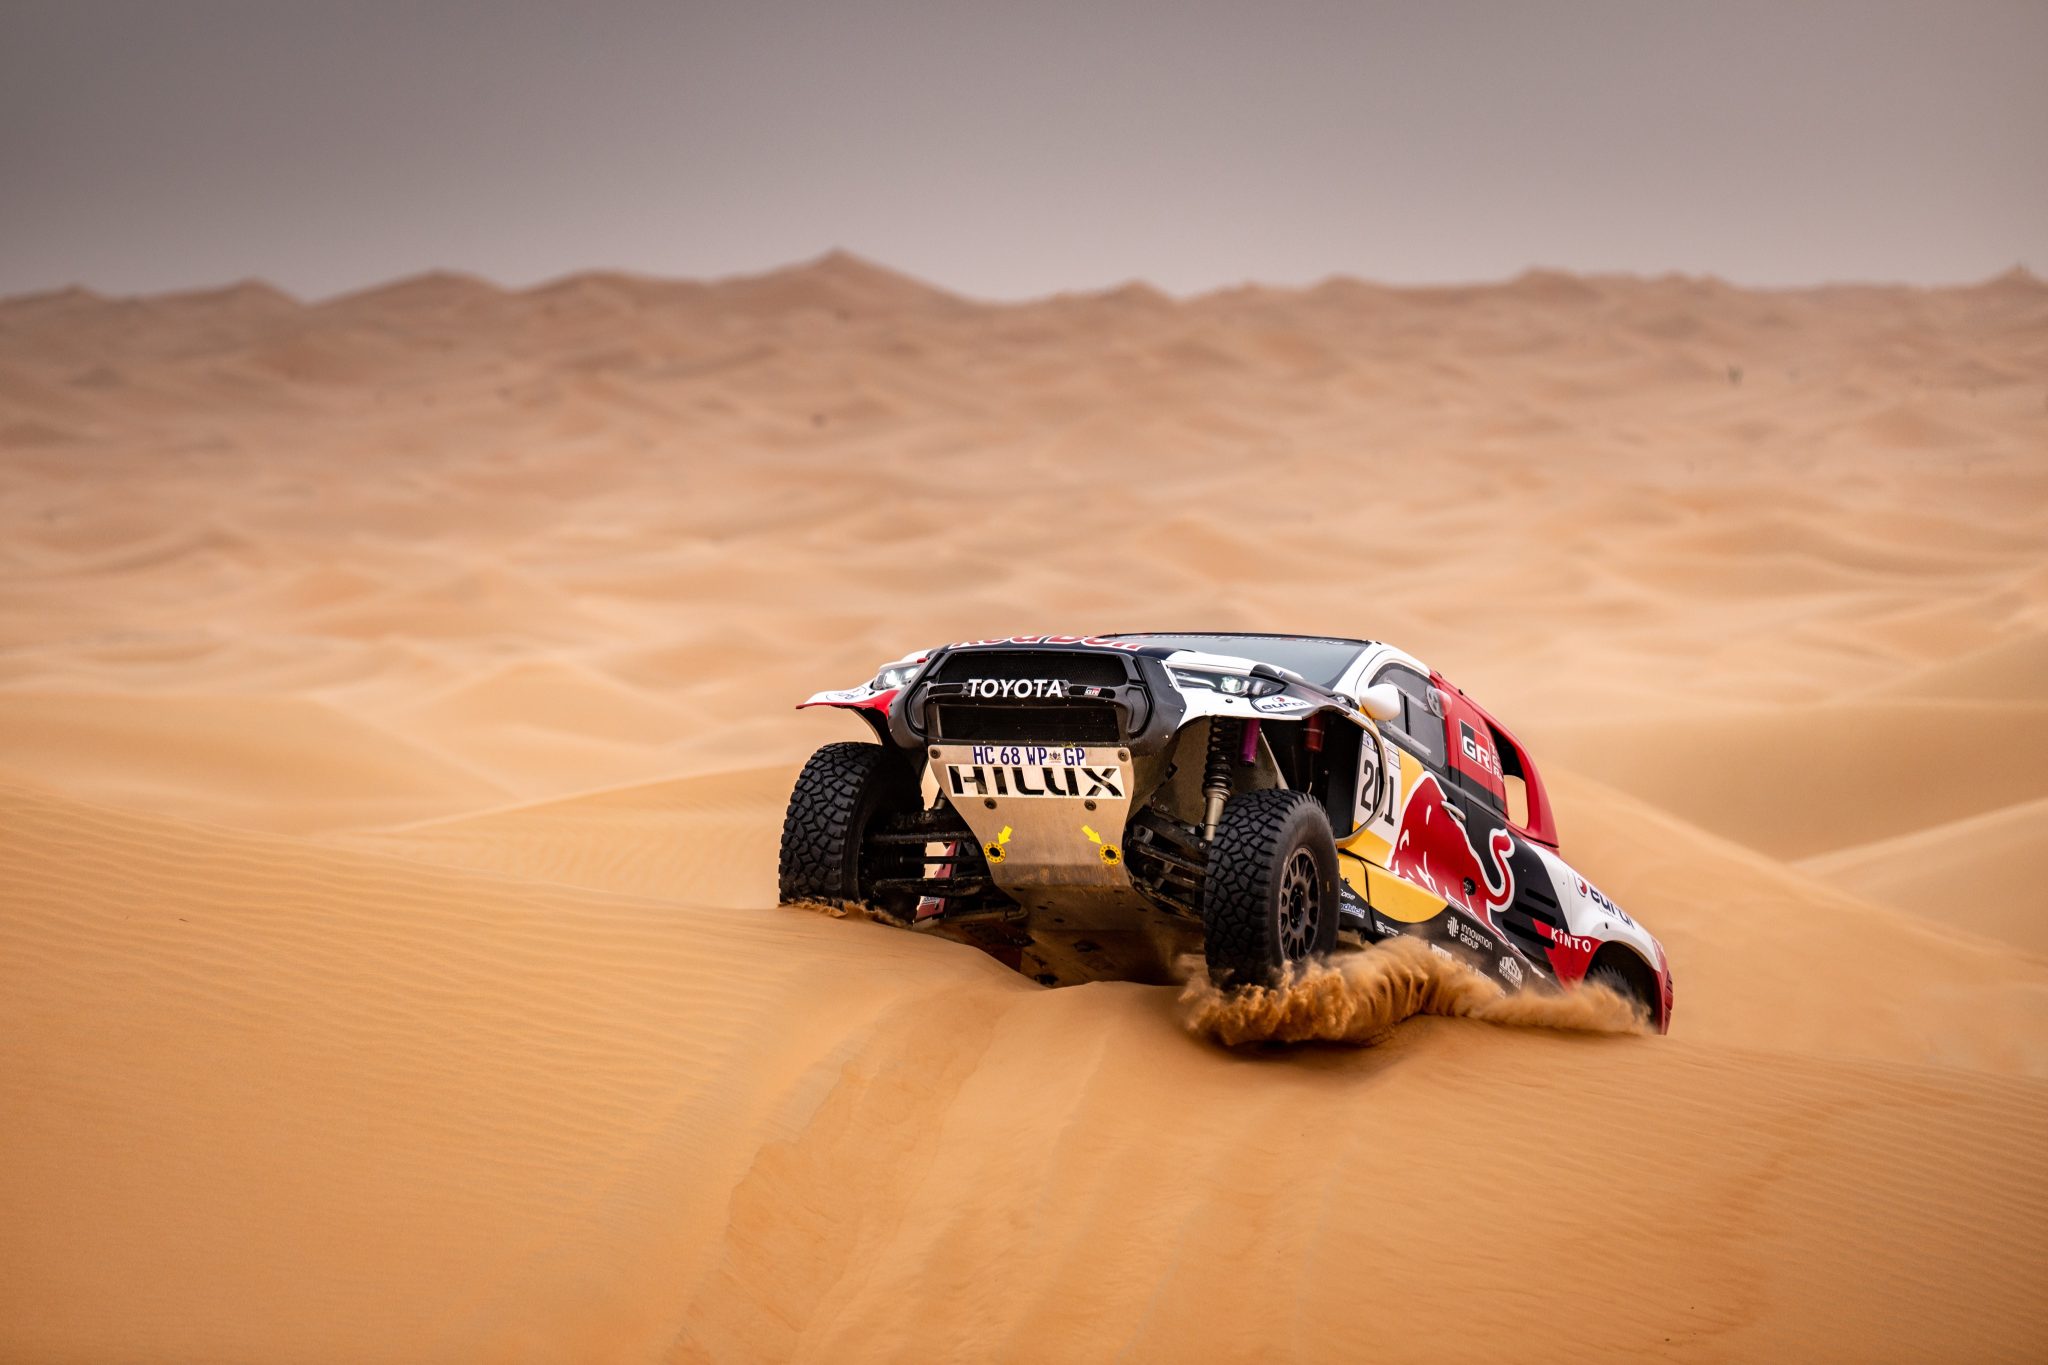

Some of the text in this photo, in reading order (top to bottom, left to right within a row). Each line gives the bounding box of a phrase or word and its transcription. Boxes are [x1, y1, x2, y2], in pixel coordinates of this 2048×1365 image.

[968, 678, 1064, 698] TOYOTA
[972, 746, 1086, 766] HC 68 WP GP
[1462, 735, 1491, 771] GR
[948, 765, 1123, 798] HILUX
[1460, 933, 1479, 950] GROUP
[1461, 923, 1493, 951] INNOVATION
